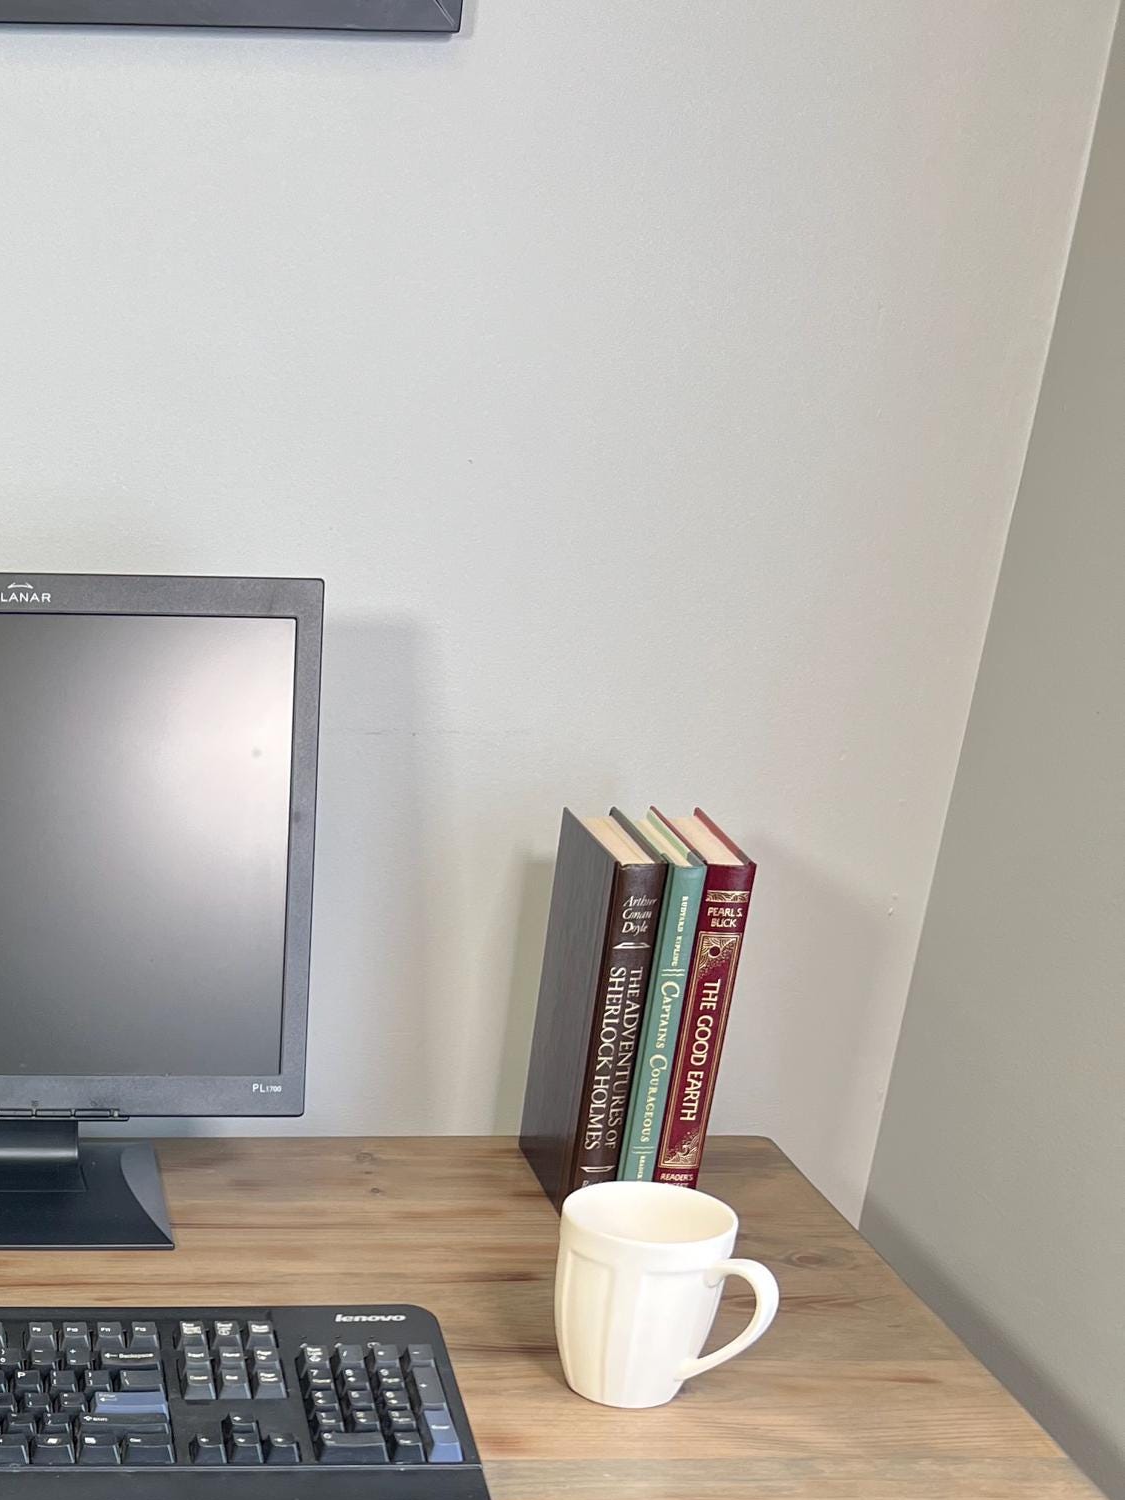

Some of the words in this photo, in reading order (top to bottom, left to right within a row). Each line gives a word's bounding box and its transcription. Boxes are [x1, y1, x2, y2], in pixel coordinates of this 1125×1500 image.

[622, 908, 653, 920] Conan
[623, 895, 657, 907] Arthur
[677, 896, 689, 932] RUDYARD
[707, 907, 735, 917] PEARL
[622, 921, 649, 936] Doyle
[711, 918, 737, 928] BUCK
[671, 936, 682, 967] KIPLING
[627, 966, 644, 998] THE
[699, 979, 721, 1011] THE
[597, 966, 627, 1071] SHERLOCK
[690, 1015, 714, 1066] GOOD
[607, 1000, 641, 1127] ADVENTURES
[252, 1083, 282, 1093] PL1700
[679, 1071, 704, 1121] EARTH
[584, 1075, 611, 1150] HOLMES
[604, 1129, 618, 1150] OF
[335, 1314, 406, 1322] lenovo
